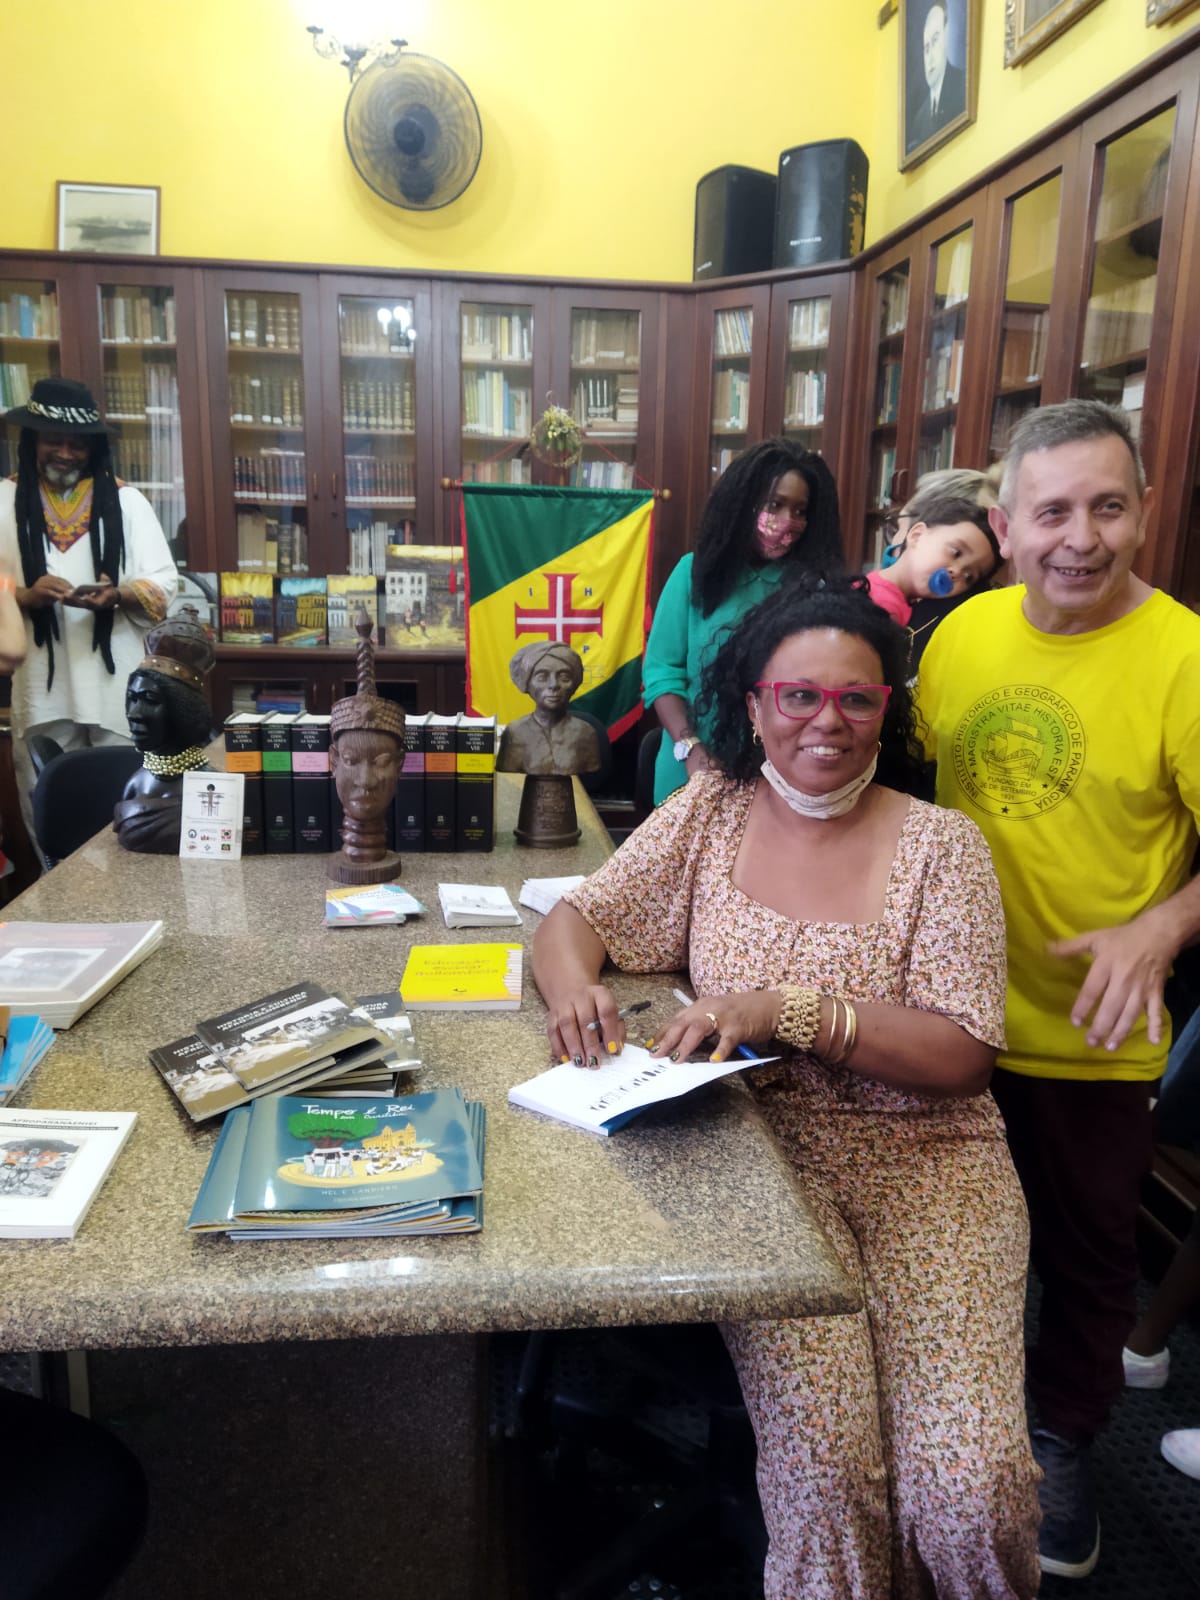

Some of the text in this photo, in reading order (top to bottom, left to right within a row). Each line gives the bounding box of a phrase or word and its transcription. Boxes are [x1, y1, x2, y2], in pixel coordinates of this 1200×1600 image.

[584, 587, 593, 597] H
[583, 645, 590, 654] P
[954, 744, 979, 799] INSTITUTO
[1003, 688, 1011, 698] E
[1071, 732, 1082, 749] DE
[967, 702, 1064, 781] MAGISTRA VITAE HISTORIA EST
[1020, 781, 1031, 789] EM
[385, 1103, 416, 1113] Rei
